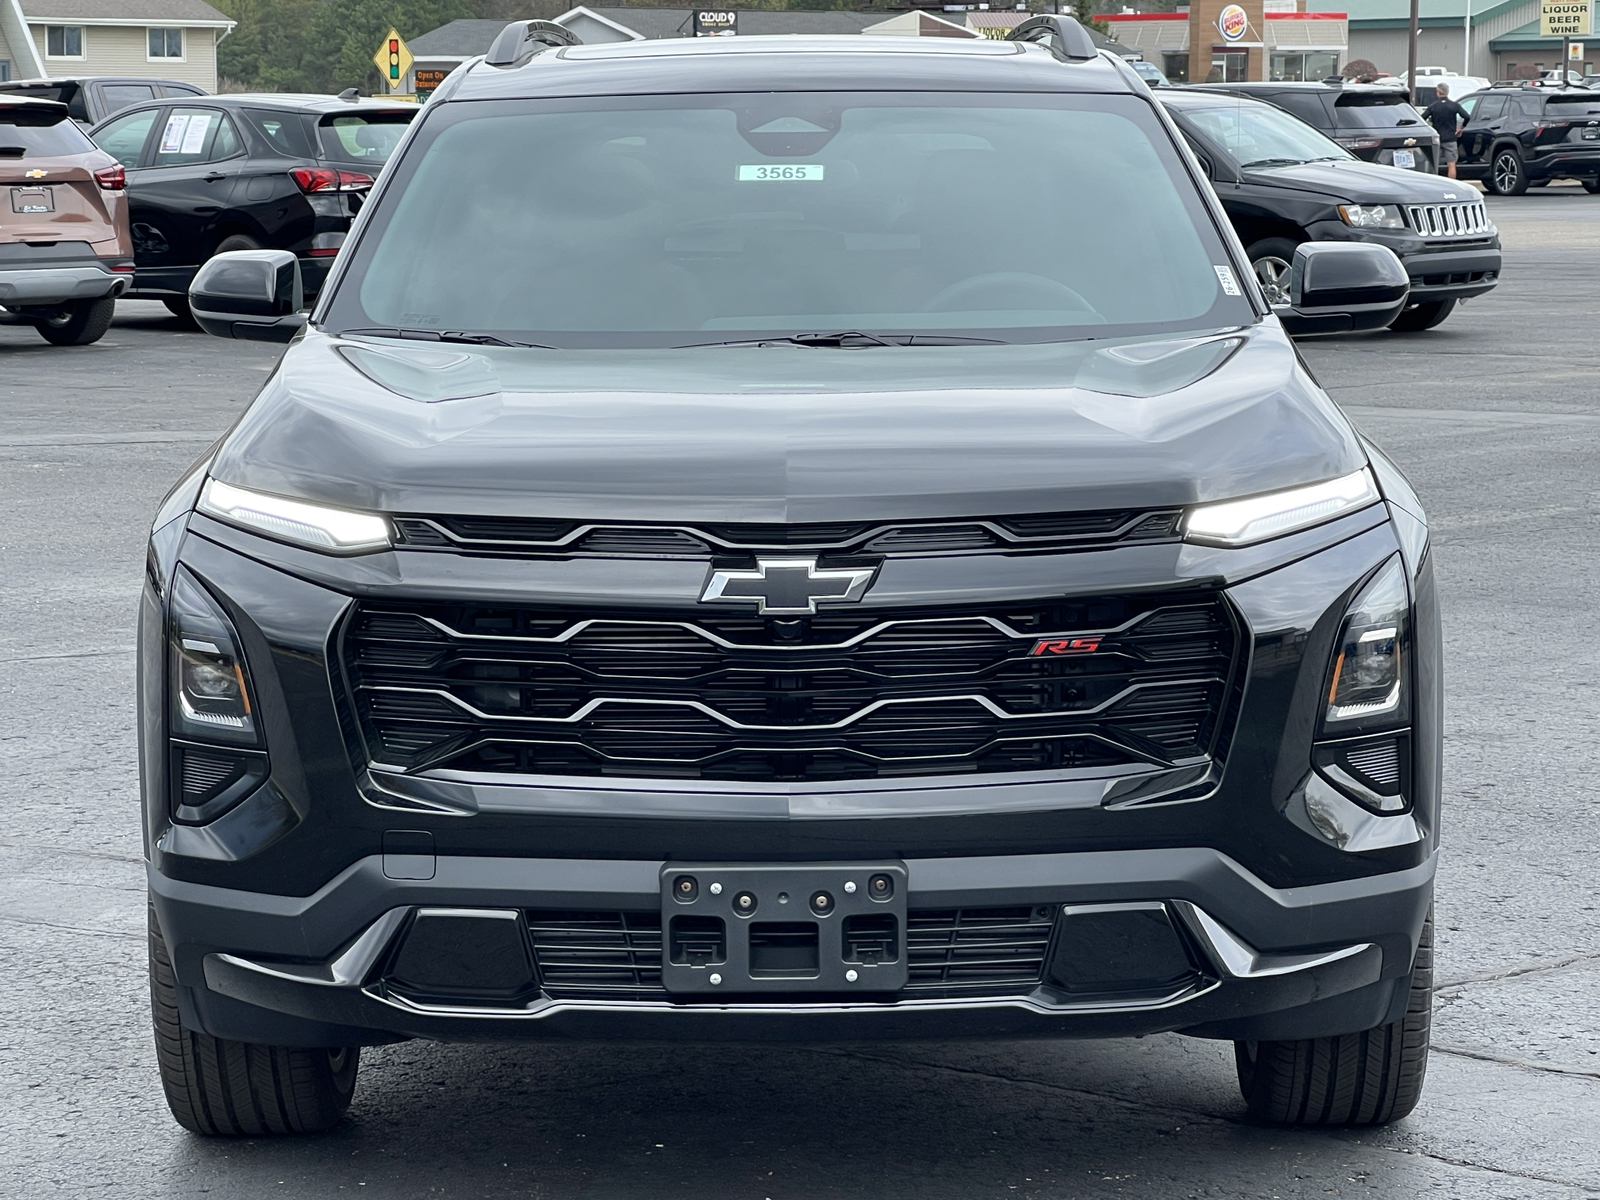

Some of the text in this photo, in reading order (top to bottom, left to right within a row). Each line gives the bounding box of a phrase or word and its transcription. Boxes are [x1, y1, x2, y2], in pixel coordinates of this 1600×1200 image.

[1543, 5, 1587, 13] LIQUOR
[699, 11, 736, 25] CLOUD 9
[1224, 11, 1244, 24] BURGER
[1549, 15, 1580, 23] BEER
[1225, 20, 1244, 31] KING
[417, 72, 434, 80] Open
[756, 167, 806, 179] 3565
[1030, 638, 1103, 656] RS
